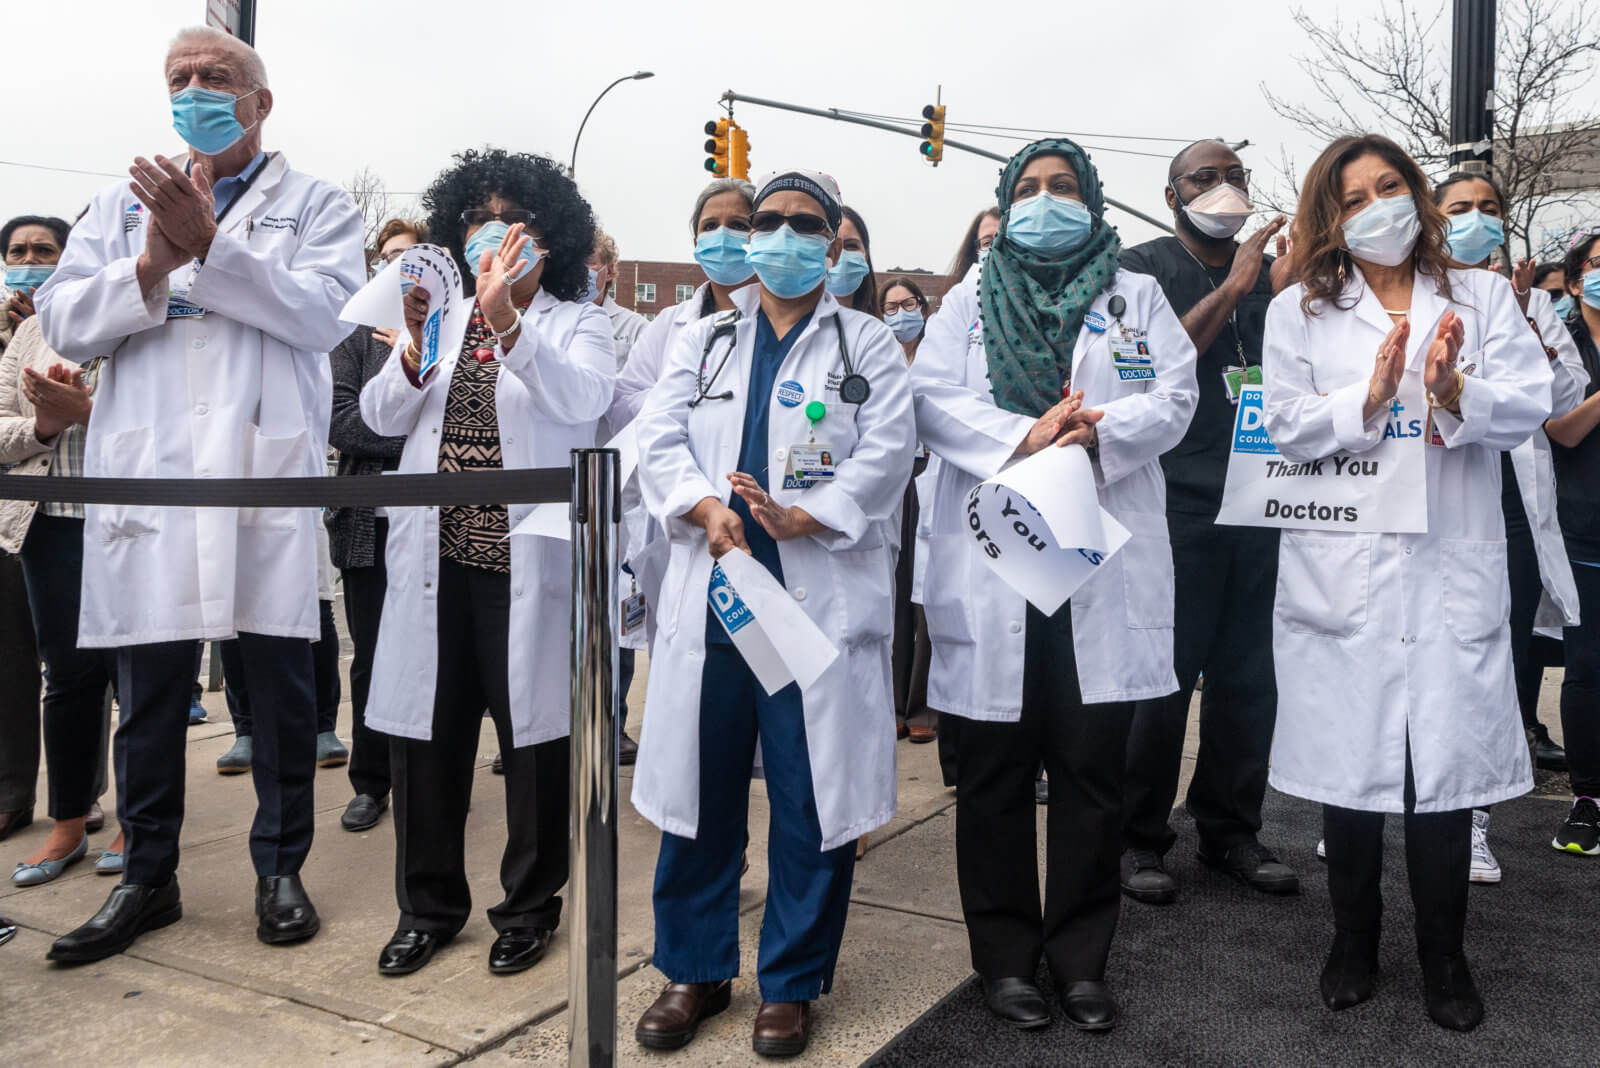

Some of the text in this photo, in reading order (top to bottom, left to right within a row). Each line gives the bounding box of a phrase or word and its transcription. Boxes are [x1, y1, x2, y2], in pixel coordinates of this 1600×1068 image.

[1121, 369, 1153, 379] DOCTOR
[777, 388, 801, 400] RESPECT
[1245, 392, 1264, 401] DO
[1266, 456, 1378, 478] Thank You
[1264, 499, 1358, 522] Doctors
[1001, 495, 1048, 552] You
